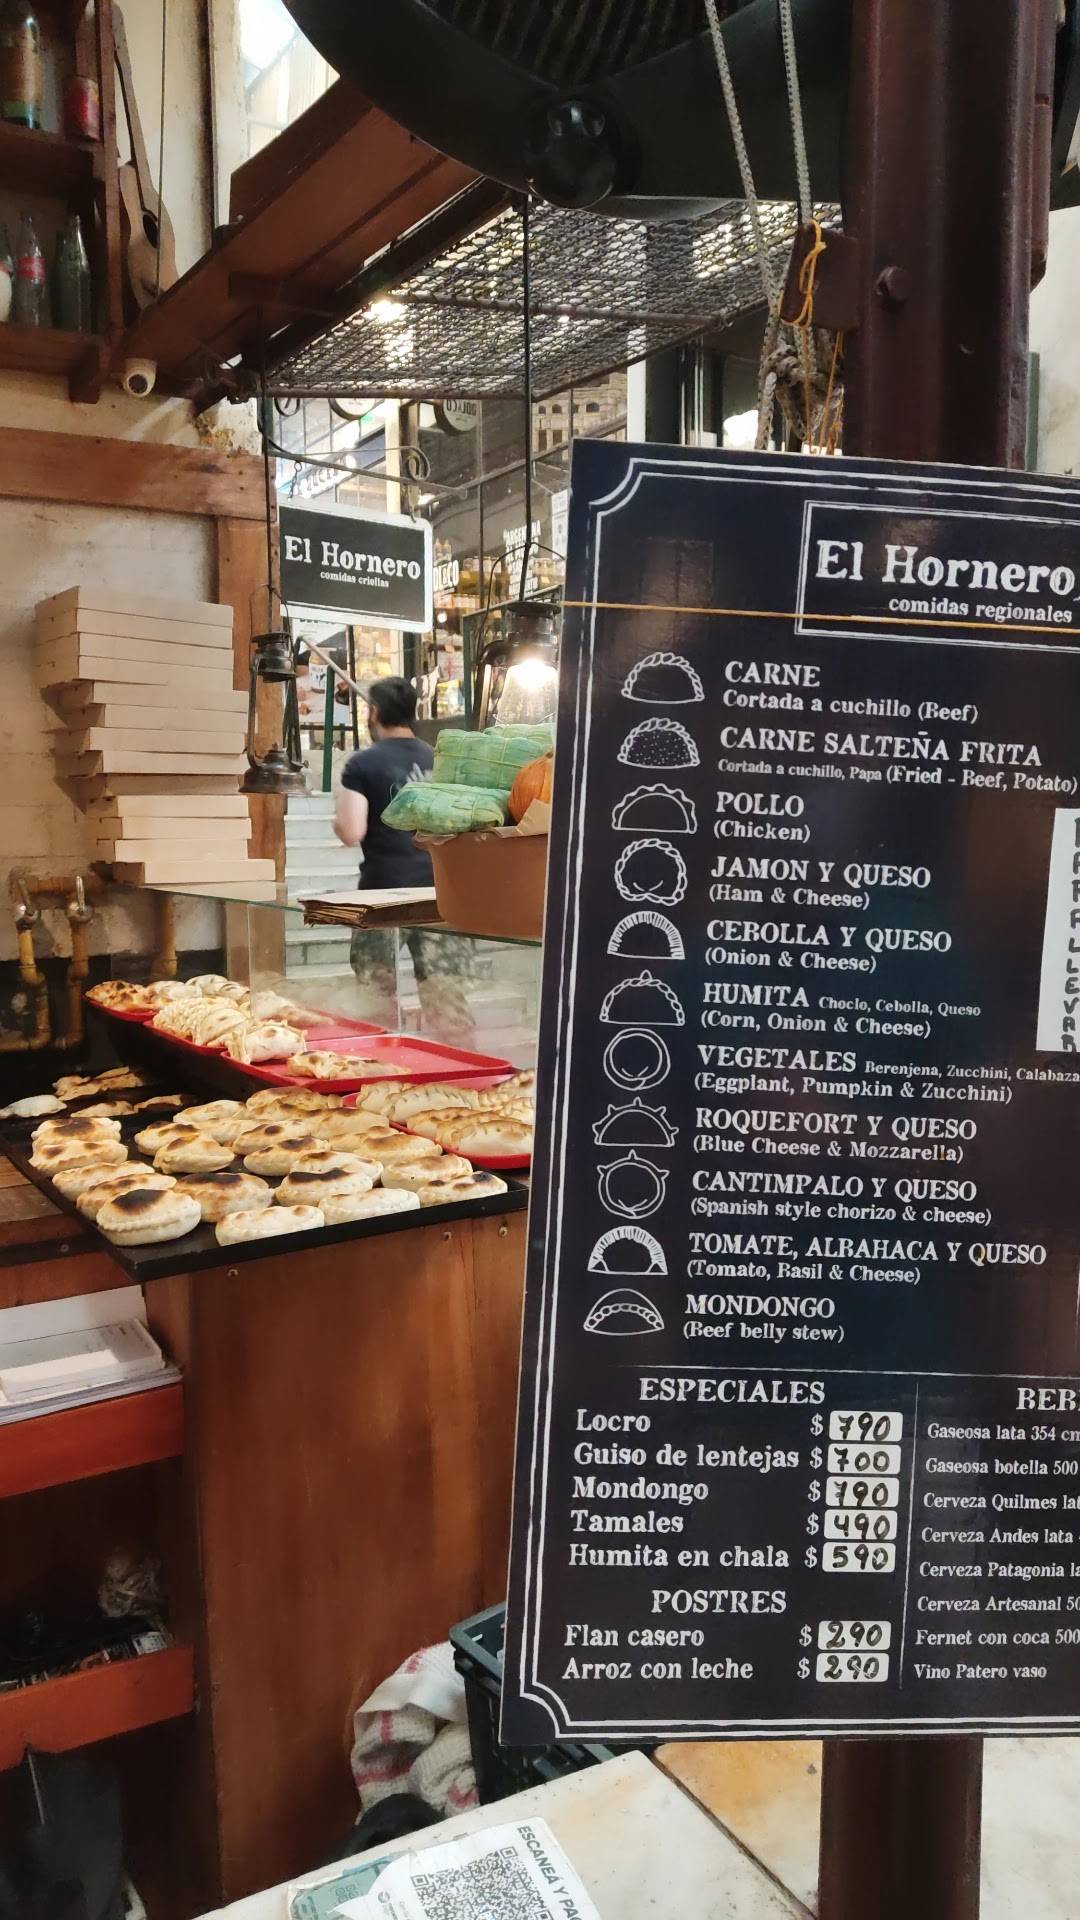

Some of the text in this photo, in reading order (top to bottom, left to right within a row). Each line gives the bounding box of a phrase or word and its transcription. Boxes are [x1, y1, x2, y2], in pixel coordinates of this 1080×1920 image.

[285, 536, 420, 580] El Hornero
[816, 540, 1075, 595] El Hornero
[320, 572, 389, 587] comidas criollas
[889, 597, 1072, 623] comidas regionales
[725, 661, 820, 687] CARNE
[723, 689, 978, 724] Cortada a cuchillo (Beef)
[721, 727, 1041, 766] CARNE SALTEÑA FRITA
[718, 759, 772, 773] Cortada
[776, 765, 784, 774] a
[788, 765, 845, 780] cuchillo,
[850, 767, 882, 782] Papa
[887, 765, 942, 784] (Fried
[961, 769, 1007, 791] Beef,
[1013, 772, 1077, 795] Potato)
[716, 792, 804, 817] POLLO
[714, 820, 810, 843] (Chicken)
[711, 856, 930, 888] JAMON Y QUESO
[710, 884, 869, 910] (Ham & Cheese)
[840, 927, 856, 947] Y
[865, 928, 951, 952] QUESO
[705, 947, 876, 973] (Onion & Cheese)
[703, 983, 981, 1016] HUMITA Choclo, Cebolla, Queso
[701, 1010, 931, 1039] (Corn, Onion & Cheese)
[697, 1045, 1080, 1082] VEGETALES Berenjena, Zucchini, Calabaza
[695, 1072, 1012, 1104] (Eggplant, Pumpkin & Zucchini)
[696, 1108, 976, 1141] ROQUEFORT Y QUESO
[694, 1135, 963, 1164] (Blue Cheese & Mozzarella)
[693, 1171, 976, 1203] CANTIMPALO Y QUESO
[691, 1197, 991, 1226] (Spanish style chorizo & cheese)
[689, 1233, 798, 1259] TOMATE,
[947, 1242, 962, 1261] Y
[969, 1243, 1046, 1266] QUESO
[687, 1260, 920, 1285] (Tomato, Basil & Cheese)
[685, 1294, 835, 1318] MONDONGO
[683, 1321, 844, 1343] (Beef belly stew)
[640, 1378, 825, 1404] ESPECIALES
[1016, 1388, 1080, 1411] BEB
[576, 1409, 650, 1432] Locro
[837, 1412, 892, 1440] 790
[928, 1423, 990, 1439] Gaseosa
[996, 1425, 1026, 1440] lata
[1031, 1426, 1056, 1440] 354
[574, 1442, 646, 1465] Guiso
[656, 1444, 687, 1466] de
[697, 1444, 799, 1473] lentejas
[833, 1447, 890, 1472] 700
[926, 1458, 1078, 1475] Gaseosa botella 500
[572, 1476, 708, 1505] Mondongo
[833, 1481, 889, 1506] 790
[924, 1493, 986, 1508] Cerveza
[992, 1494, 1057, 1511] Quilmes
[571, 1510, 683, 1533] Tamales
[834, 1517, 890, 1540] 490
[922, 1527, 1073, 1543] Cerveza Andes lata
[569, 1544, 668, 1566] Humita
[678, 1550, 709, 1567] en
[720, 1545, 789, 1567] chala
[832, 1544, 889, 1571] 590
[920, 1562, 982, 1576] Cerveza
[988, 1562, 1064, 1581] Patagonia
[651, 1590, 786, 1613] POSTRES
[918, 1596, 980, 1611] Cerveza
[985, 1596, 1061, 1611] Artesanal
[564, 1624, 618, 1646] Flan
[628, 1629, 704, 1646] casero
[825, 1622, 883, 1648] 290
[916, 1629, 1080, 1645] Fernet con coca 500
[562, 1657, 631, 1679] Arroz
[641, 1663, 681, 1679] con
[691, 1657, 753, 1679] leche
[824, 1656, 879, 1680] 290
[914, 1664, 1047, 1679] Vino Patero vaso
[552, 1885, 569, 1895] Y
